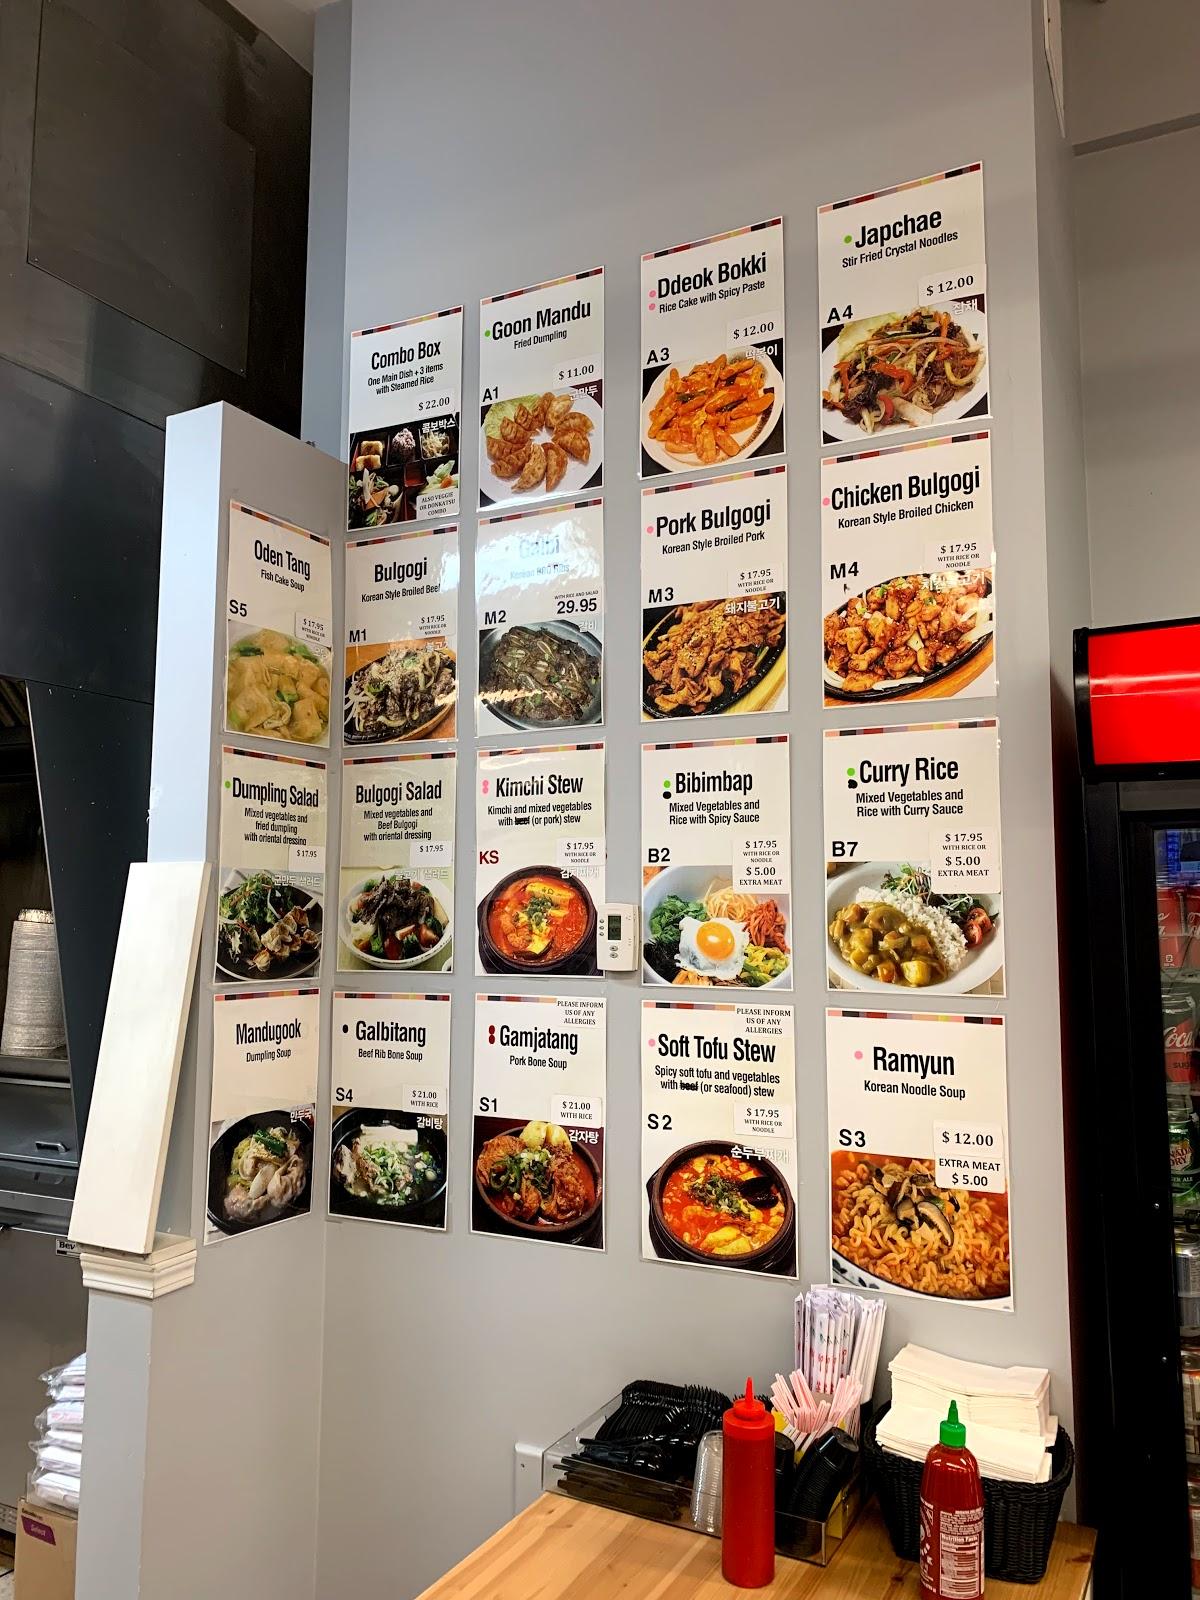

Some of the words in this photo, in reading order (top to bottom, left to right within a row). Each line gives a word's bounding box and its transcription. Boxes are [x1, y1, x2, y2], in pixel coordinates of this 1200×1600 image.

[854, 210, 942, 248] Japchae
[842, 256, 858, 268] Stir
[860, 249, 883, 264] Fried
[885, 240, 917, 258] Crystal
[919, 231, 958, 249] Noodles
[657, 267, 714, 299] Ddeok
[718, 251, 766, 284] Bokki
[937, 275, 974, 294] 12.00
[659, 303, 677, 314] Rice
[678, 296, 698, 309] Cake
[700, 291, 717, 304] with
[718, 286, 740, 299] Spicy
[742, 280, 765, 293] Paste
[492, 316, 532, 341] Goon
[536, 300, 591, 330] Mandu
[743, 321, 774, 338] 12.00
[514, 336, 532, 350] Fried
[533, 329, 567, 345] Dumpling
[371, 346, 414, 370] Combo
[418, 341, 441, 360] Box
[567, 364, 594, 378] 11.00
[376, 384, 390, 395] with
[390, 378, 419, 392] Steamed
[420, 375, 434, 385] Rice
[482, 386, 499, 403] A1
[421, 417, 456, 434] 콤보박스
[831, 482, 903, 511] Chicken
[908, 465, 980, 499] Bulgogi
[656, 512, 697, 538] Pork
[701, 499, 771, 531] Bulgogi
[838, 514, 871, 529] Korean
[873, 510, 896, 524] Style
[899, 504, 932, 520] Broiled
[935, 500, 974, 514] Chicken
[662, 543, 691, 555] Korean
[692, 538, 712, 551] Style
[714, 533, 744, 547] Broiled
[745, 530, 765, 542] Pork
[949, 542, 977, 554] 17.95
[254, 539, 283, 568] Oden
[285, 550, 311, 581] Tang
[374, 556, 427, 583] Bulgogi
[945, 561, 971, 569] NOODLE
[260, 569, 274, 582] Fish
[274, 573, 290, 586] Cake
[290, 579, 305, 593] Soup
[361, 593, 384, 603] Korean
[384, 589, 401, 601] Style
[402, 585, 425, 597] Broiled
[229, 599, 248, 617] S5
[557, 597, 597, 614] 29.95
[725, 596, 780, 615] 돼지불고기
[484, 610, 507, 625] M2
[349, 628, 367, 643] M1
[859, 759, 910, 787] Curry
[915, 757, 959, 781] Rice
[496, 775, 544, 797] Kimchi
[547, 774, 584, 795] Stew
[675, 770, 753, 795] Bibimbap
[232, 777, 287, 808] Dumpling
[289, 785, 319, 808] Salad
[356, 783, 402, 806] Bulgogi
[405, 780, 442, 801] Salad
[856, 792, 886, 804] Mixed
[887, 790, 943, 804] Vegetables
[944, 789, 964, 801] and
[363, 810, 383, 819] Mixed
[384, 808, 419, 820] vegetables
[420, 807, 433, 817] and
[487, 805, 512, 815] Kimchi
[513, 804, 527, 814] and
[528, 803, 551, 813] mixed
[552, 801, 592, 813] vegetables
[669, 802, 697, 813] Mixed
[696, 800, 742, 813] Vegetables
[744, 799, 760, 810] and
[856, 806, 878, 817] Rice
[880, 805, 901, 816] with
[903, 804, 930, 818] Curry
[932, 803, 963, 815] Sauce
[669, 815, 688, 825] Rice
[689, 814, 707, 824] with
[708, 813, 731, 826] Spicy
[733, 813, 760, 823] Sauce
[479, 850, 499, 865] KS
[648, 847, 671, 863] B2
[832, 841, 859, 857] B7
[236, 1018, 301, 1045] Mandugook
[355, 1020, 426, 1047] Galbitang
[500, 1024, 578, 1055] Gamjatang
[246, 1050, 276, 1063] Dumpling
[276, 1048, 292, 1059] Soup
[358, 1048, 374, 1058] Beef
[374, 1049, 386, 1059] Rib
[387, 1050, 405, 1059] Bone
[405, 1050, 423, 1062] Soup
[658, 1033, 690, 1058] Soft
[693, 1035, 728, 1060] Tofu
[733, 1037, 776, 1063] Stew
[509, 1055, 526, 1066] Pork
[528, 1056, 547, 1067] Bone
[548, 1057, 567, 1071] Soup
[873, 1046, 955, 1080] Ramyun
[655, 1064, 678, 1078] Spicy
[679, 1067, 695, 1078] soft
[696, 1069, 712, 1079] tofu
[714, 1070, 730, 1081] and
[732, 1072, 780, 1084] vegetables
[335, 1087, 353, 1102] S4
[660, 1079, 678, 1090] with
[700, 1082, 713, 1094] (or
[714, 1083, 751, 1098] seafood)
[753, 1086, 775, 1097] stew
[864, 1080, 899, 1094] Korean
[901, 1083, 937, 1097] Noodle
[939, 1085, 966, 1101] Soup
[479, 1096, 497, 1113] S1
[568, 1129, 600, 1145] 감자탕
[839, 1128, 866, 1148] S3
[954, 1132, 994, 1147] 12.00
[939, 1158, 969, 1169] EXTRA
[972, 1161, 1001, 1172] MEAT
[962, 1175, 988, 1187] 5.00
